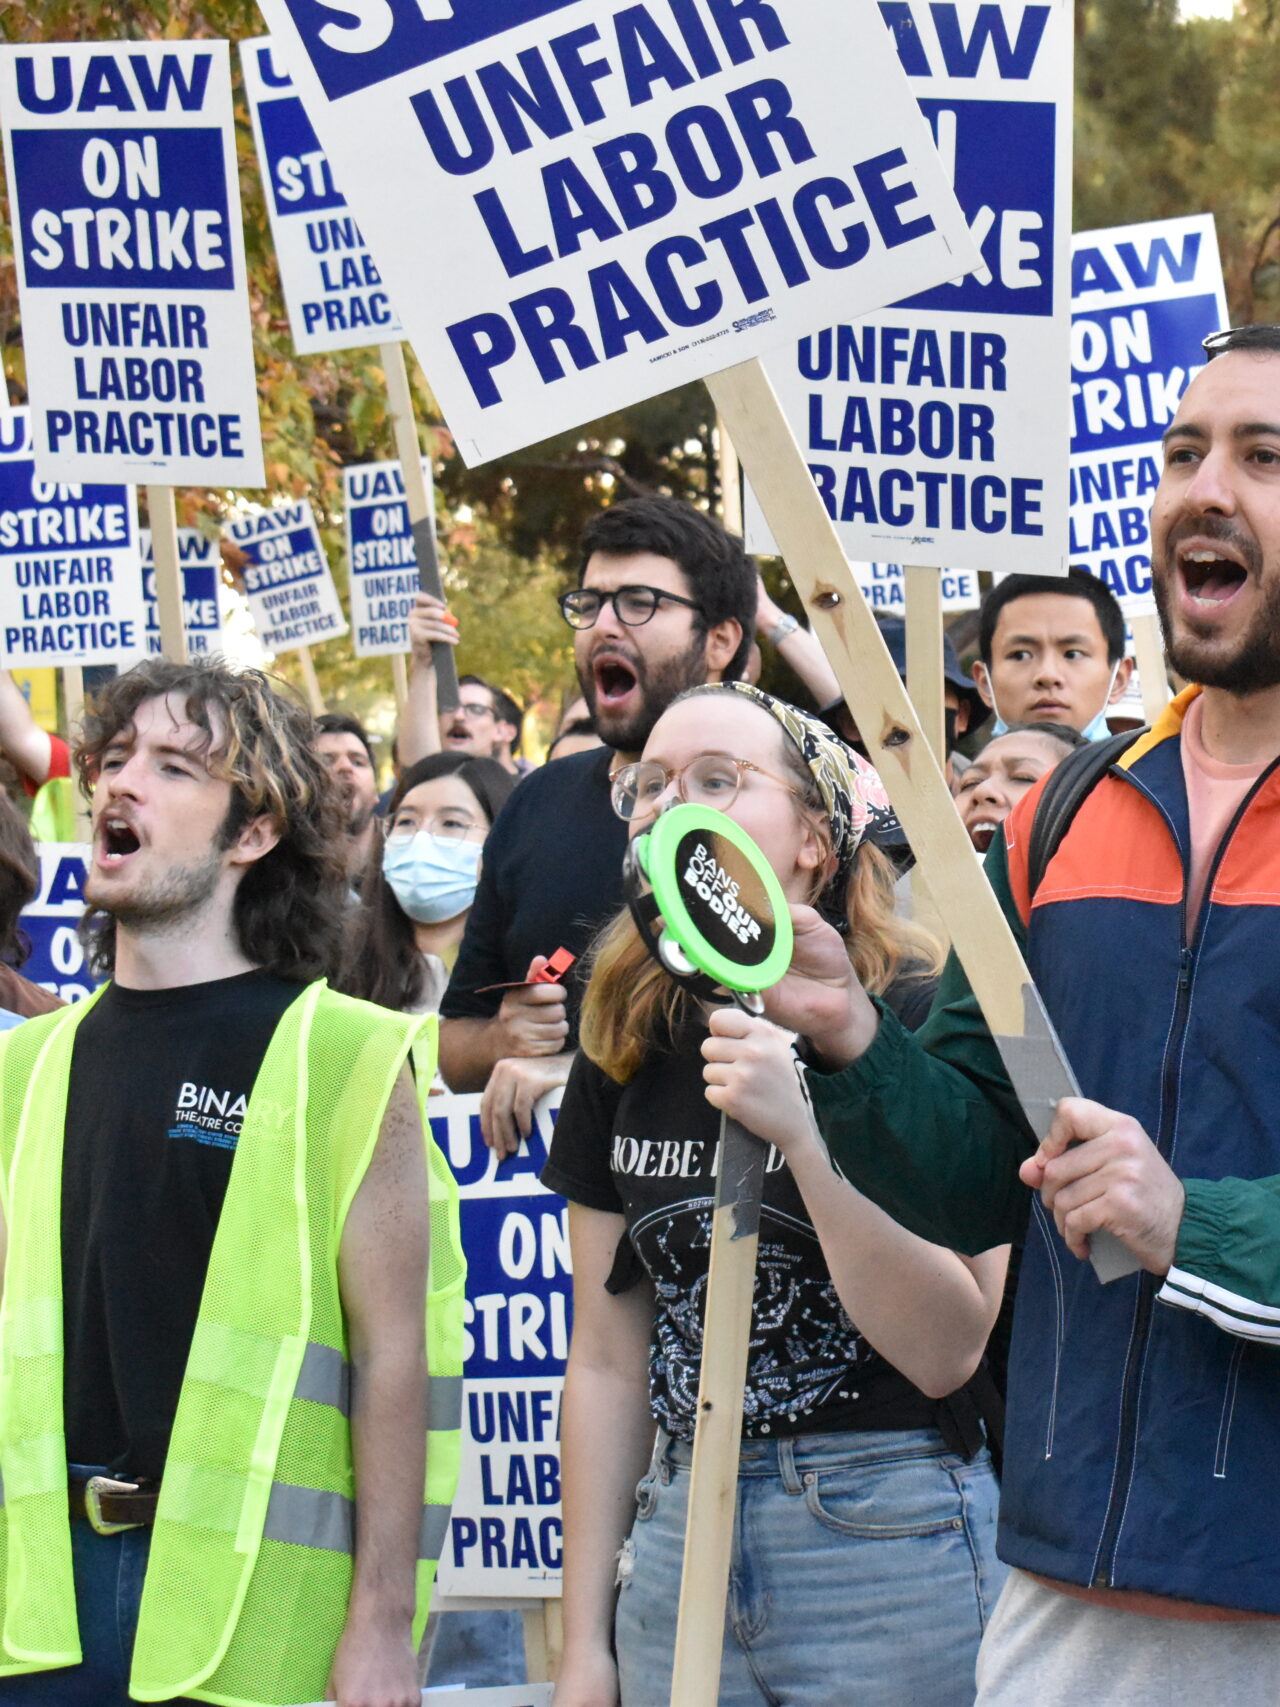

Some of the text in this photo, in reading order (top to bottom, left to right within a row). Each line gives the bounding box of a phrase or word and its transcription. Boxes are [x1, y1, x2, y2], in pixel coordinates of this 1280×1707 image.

[877, 1, 1051, 80] AW
[15, 54, 212, 115] UAW
[409, 0, 790, 176] UNFAIR
[82, 136, 160, 200] ON
[473, 78, 817, 278] LABOR
[30, 207, 225, 271] STRIKE
[319, 254, 382, 292] LAB
[447, 147, 936, 409] PRACTICE
[1072, 232, 1202, 299] AW
[61, 303, 208, 349] UNFAIR
[302, 291, 391, 335] PRAC
[798, 325, 1006, 391] UNFAIR
[1071, 309, 1152, 373] ON
[74, 356, 205, 403] LABOR
[1070, 365, 1196, 437] TRIK
[46, 410, 244, 458] PRACTICE
[809, 394, 995, 462] LABOR
[806, 463, 1043, 537] RACTICE
[1070, 456, 1160, 507] NFA
[0, 504, 126, 547] STRIKE
[232, 506, 303, 540] UAW
[372, 507, 404, 536] ON
[1069, 506, 1152, 555] LAB
[15, 557, 114, 588] UNFAIR
[245, 550, 320, 591] STRIKE
[259, 535, 292, 561] ON
[354, 537, 415, 568] STRIK
[22, 590, 110, 620] LABOR
[262, 583, 318, 610] UNFAIR
[270, 600, 320, 626] LABOR
[369, 599, 415, 622] LABO
[5, 621, 135, 654] PRACTICE
[264, 614, 336, 646] PRACTICE
[359, 623, 407, 646] PRACT
[694, 844, 740, 897] BANS
[684, 868, 748, 943] BODIES
[689, 856, 762, 941] OFF OUR
[175, 1110, 222, 1130] THEATRE
[429, 1108, 559, 1186] UA
[610, 1135, 704, 1177] HOEBE
[499, 1212, 573, 1280] ON
[463, 1292, 568, 1362] STRI
[468, 1391, 562, 1443] UNF
[480, 1454, 561, 1505] LAB
[452, 1516, 563, 1569] PRAC
